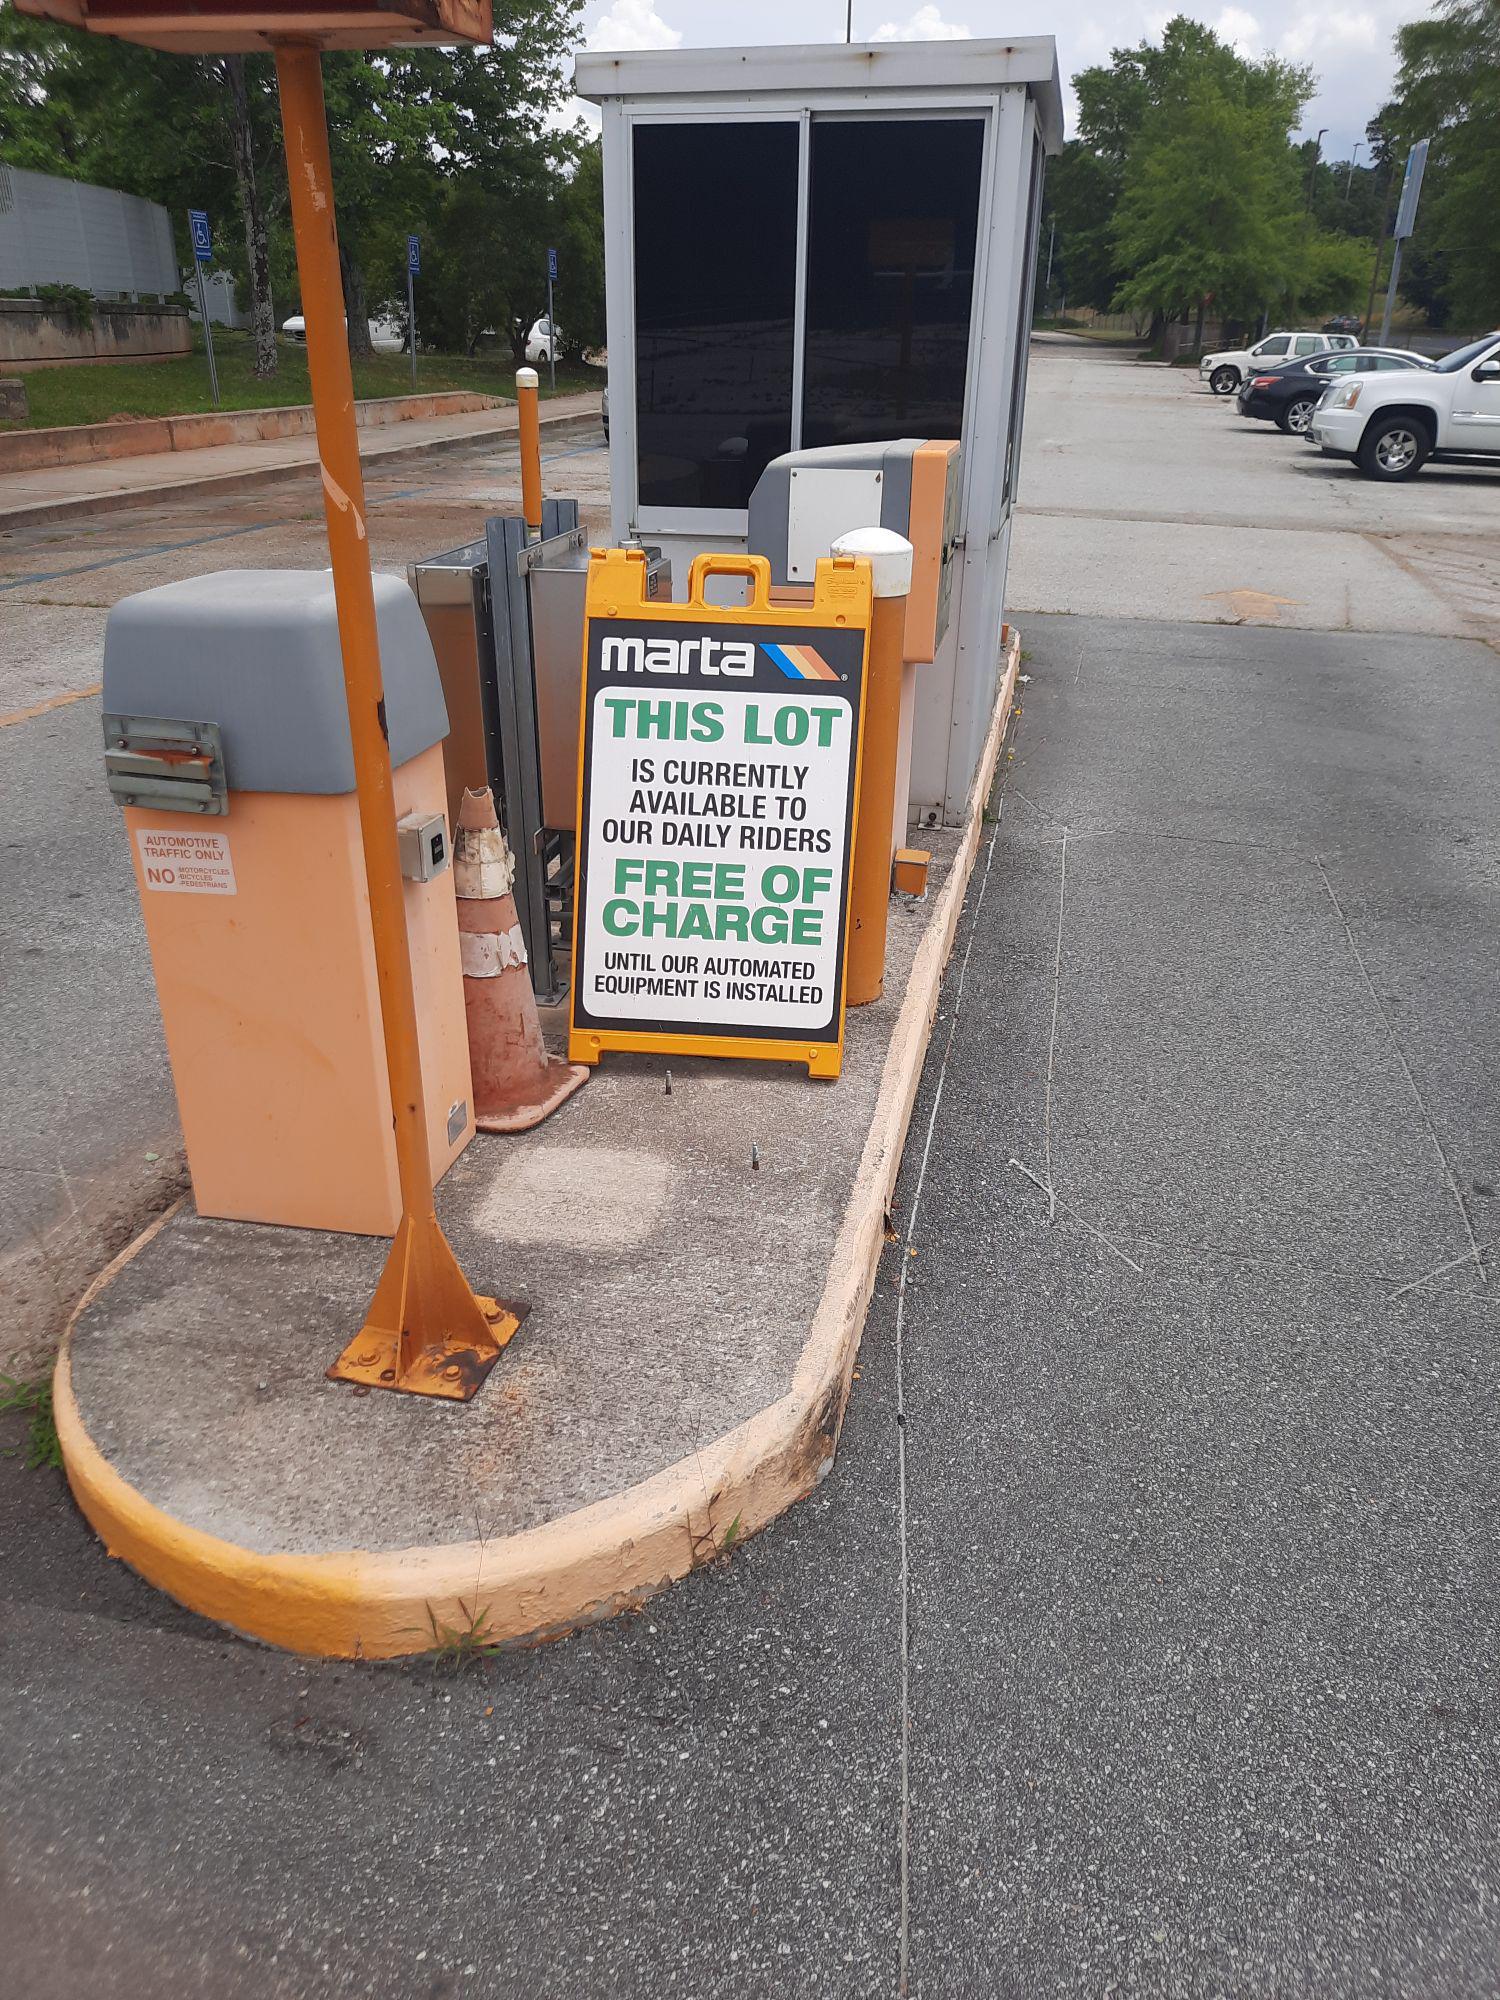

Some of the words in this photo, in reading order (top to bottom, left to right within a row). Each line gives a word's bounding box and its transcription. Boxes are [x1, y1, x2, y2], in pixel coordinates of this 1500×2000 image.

[600, 636, 756, 677] marta
[604, 698, 725, 743] THIS
[743, 704, 843, 748] LOT
[631, 758, 655, 784] IS
[663, 759, 810, 790] CURRENTLY
[629, 789, 767, 820] AVAILABLE
[774, 796, 807, 822] TO
[146, 836, 219, 848] AUTOMOTIVE
[602, 818, 653, 845] OUR
[661, 821, 732, 848] DAILY
[739, 825, 832, 854] RIDERS
[144, 848, 191, 859] TRAFFIC
[195, 850, 224, 860] ONLY
[147, 867, 175, 884] NO
[179, 867, 230, 875] MOTORCYCLES
[614, 858, 746, 901] FREE
[761, 865, 833, 904] OF
[602, 898, 824, 946] CHARGE
[604, 951, 657, 972] UNTIL
[661, 954, 699, 974] OUR
[703, 957, 815, 980] AUTOMATED
[594, 974, 699, 998] EQUIPMENT
[703, 980, 721, 999] IS
[726, 981, 823, 1005] INSTALLED
